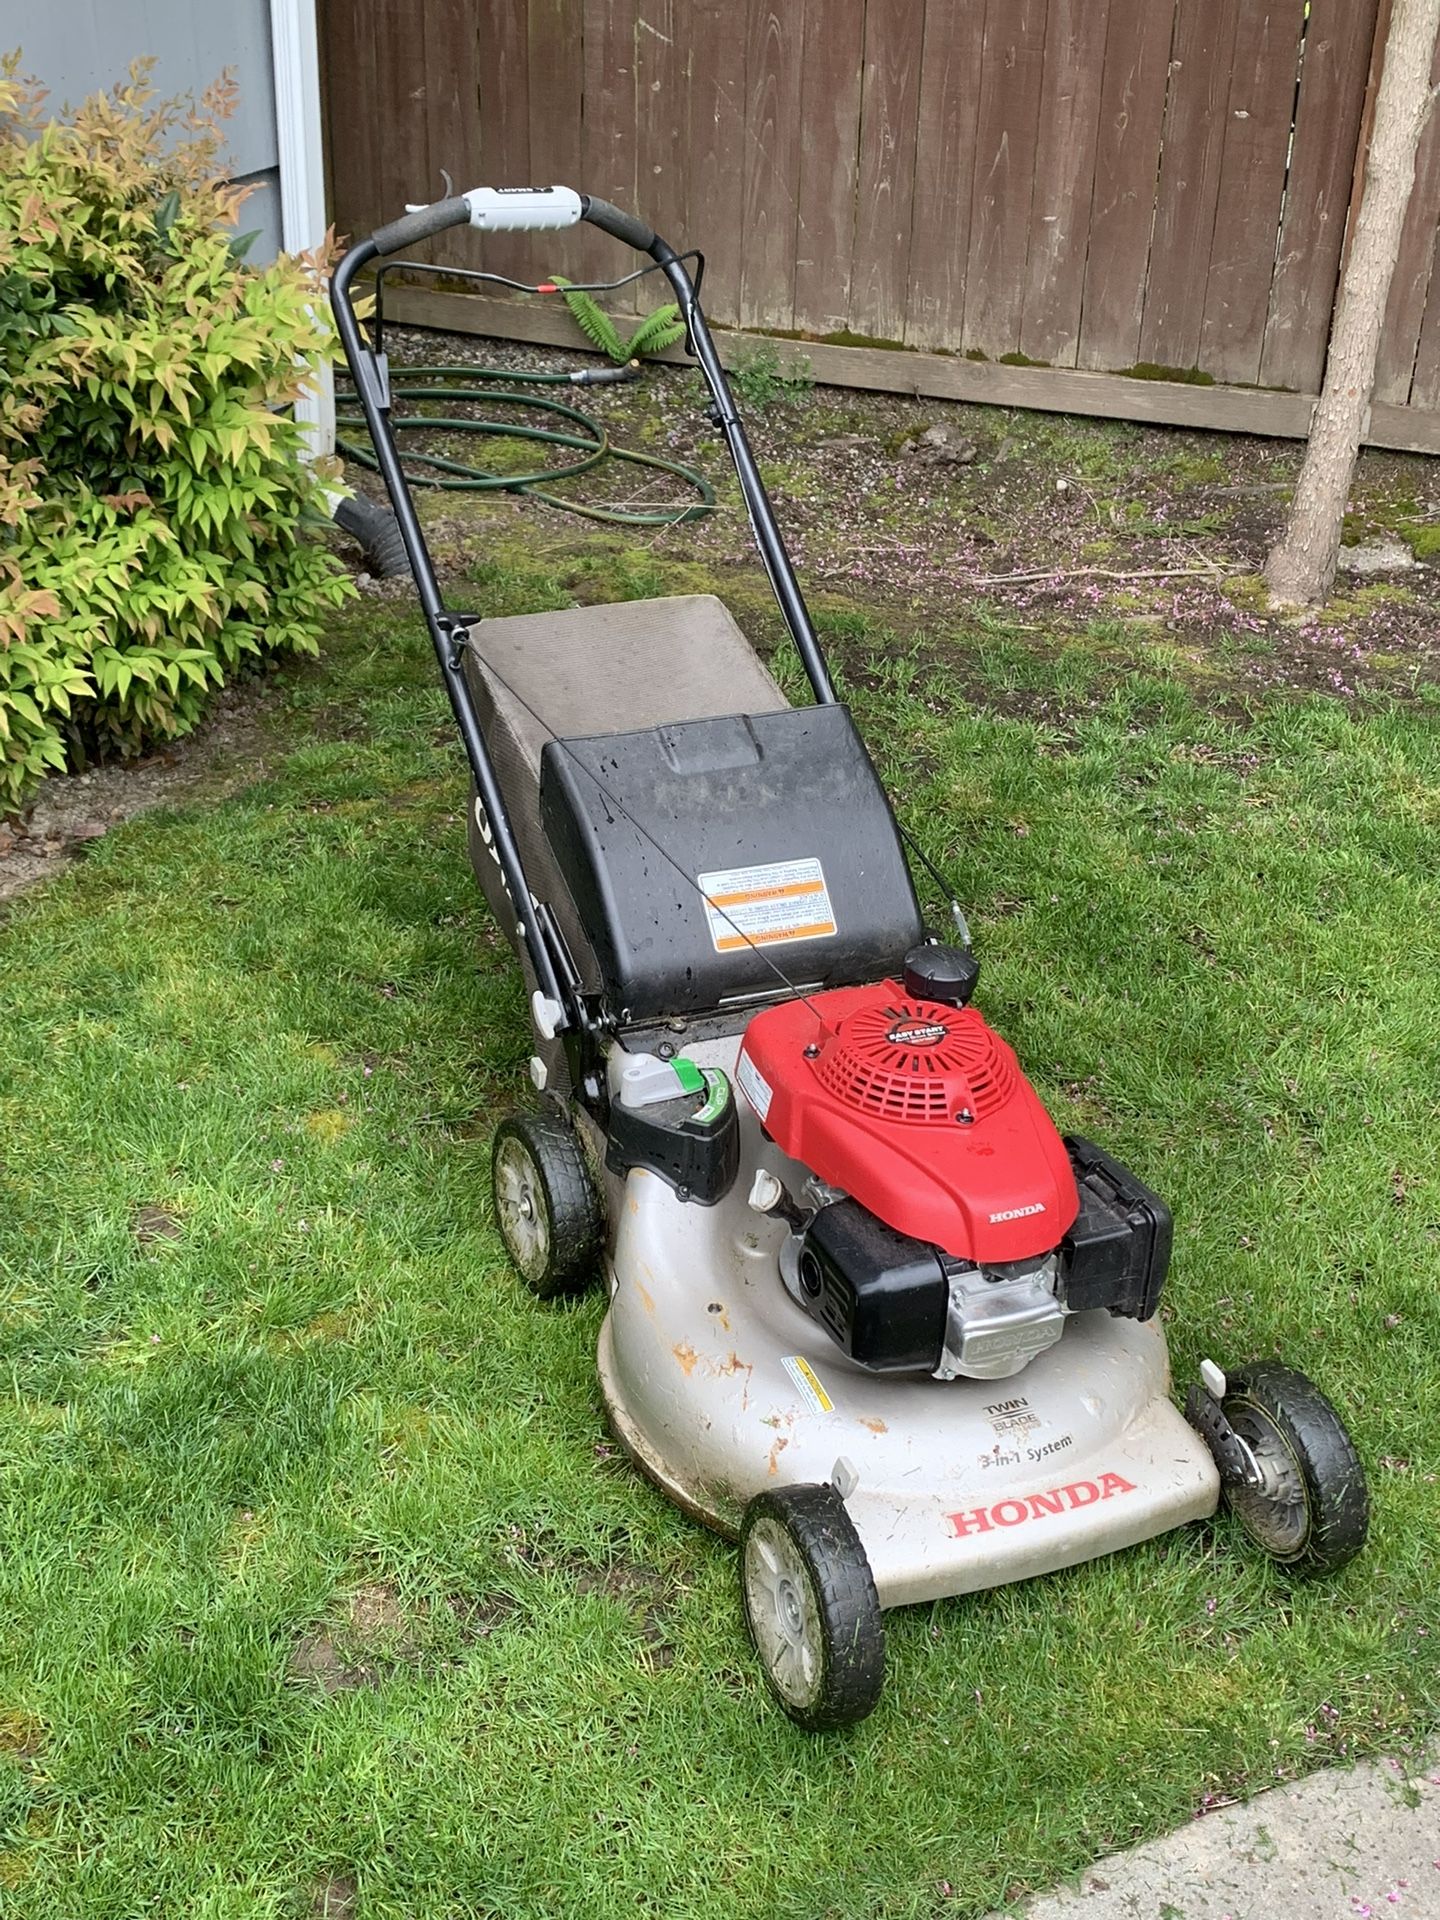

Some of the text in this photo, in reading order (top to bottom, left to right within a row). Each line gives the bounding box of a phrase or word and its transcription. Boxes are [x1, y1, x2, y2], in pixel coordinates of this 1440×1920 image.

[889, 1030, 913, 1041] EASY
[914, 1025, 943, 1036] START
[989, 1202, 1046, 1225] HONDA
[970, 1325, 1057, 1355] HONDA
[982, 1397, 1029, 1415] TWIN
[992, 1413, 1038, 1432] BLADE
[980, 1433, 1073, 1469] 3-in-1 System
[946, 1472, 1138, 1539] HONDA
